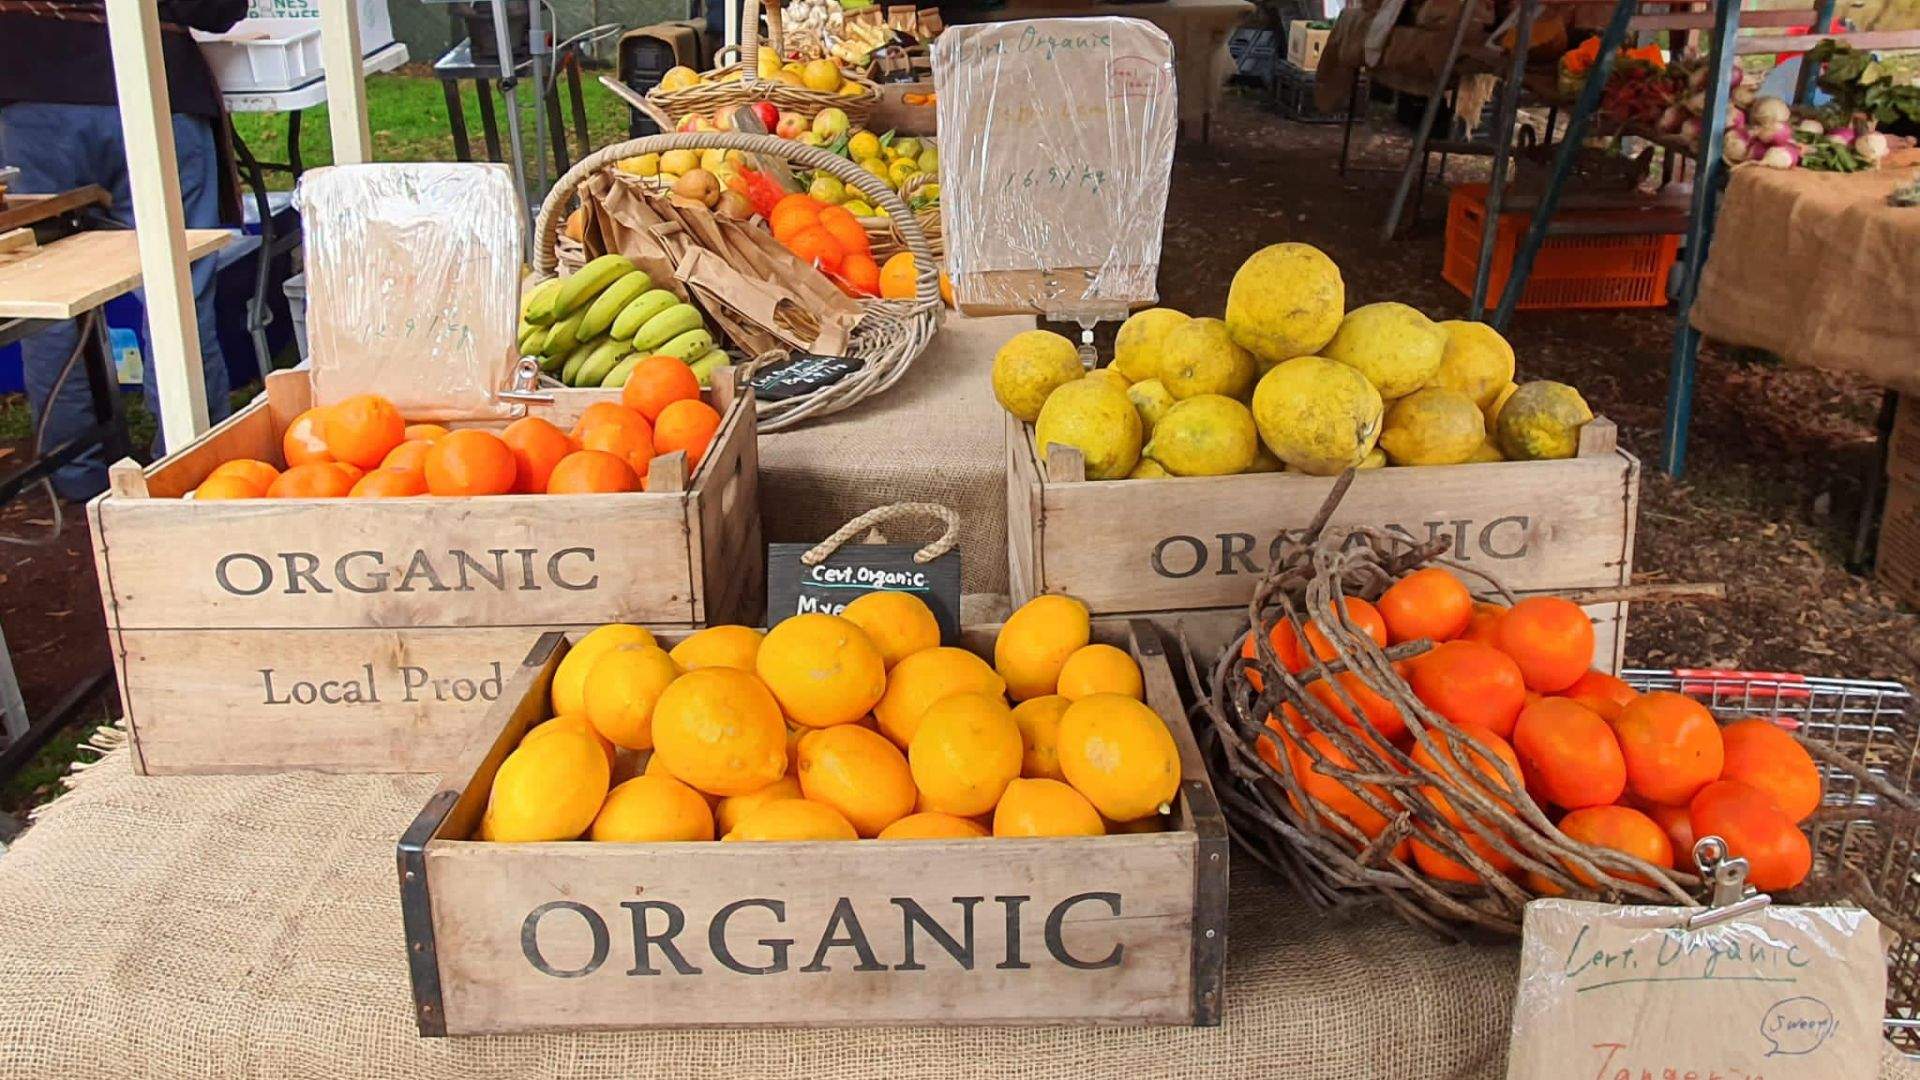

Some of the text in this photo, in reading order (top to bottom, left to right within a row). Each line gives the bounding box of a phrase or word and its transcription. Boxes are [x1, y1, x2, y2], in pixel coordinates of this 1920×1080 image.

[1018, 26, 1111, 60] Organic
[215, 547, 599, 596] ORGANIC
[258, 661, 502, 705] Local Prod
[520, 891, 1125, 978] ORGANIC
[1566, 925, 1638, 978] Cert.
